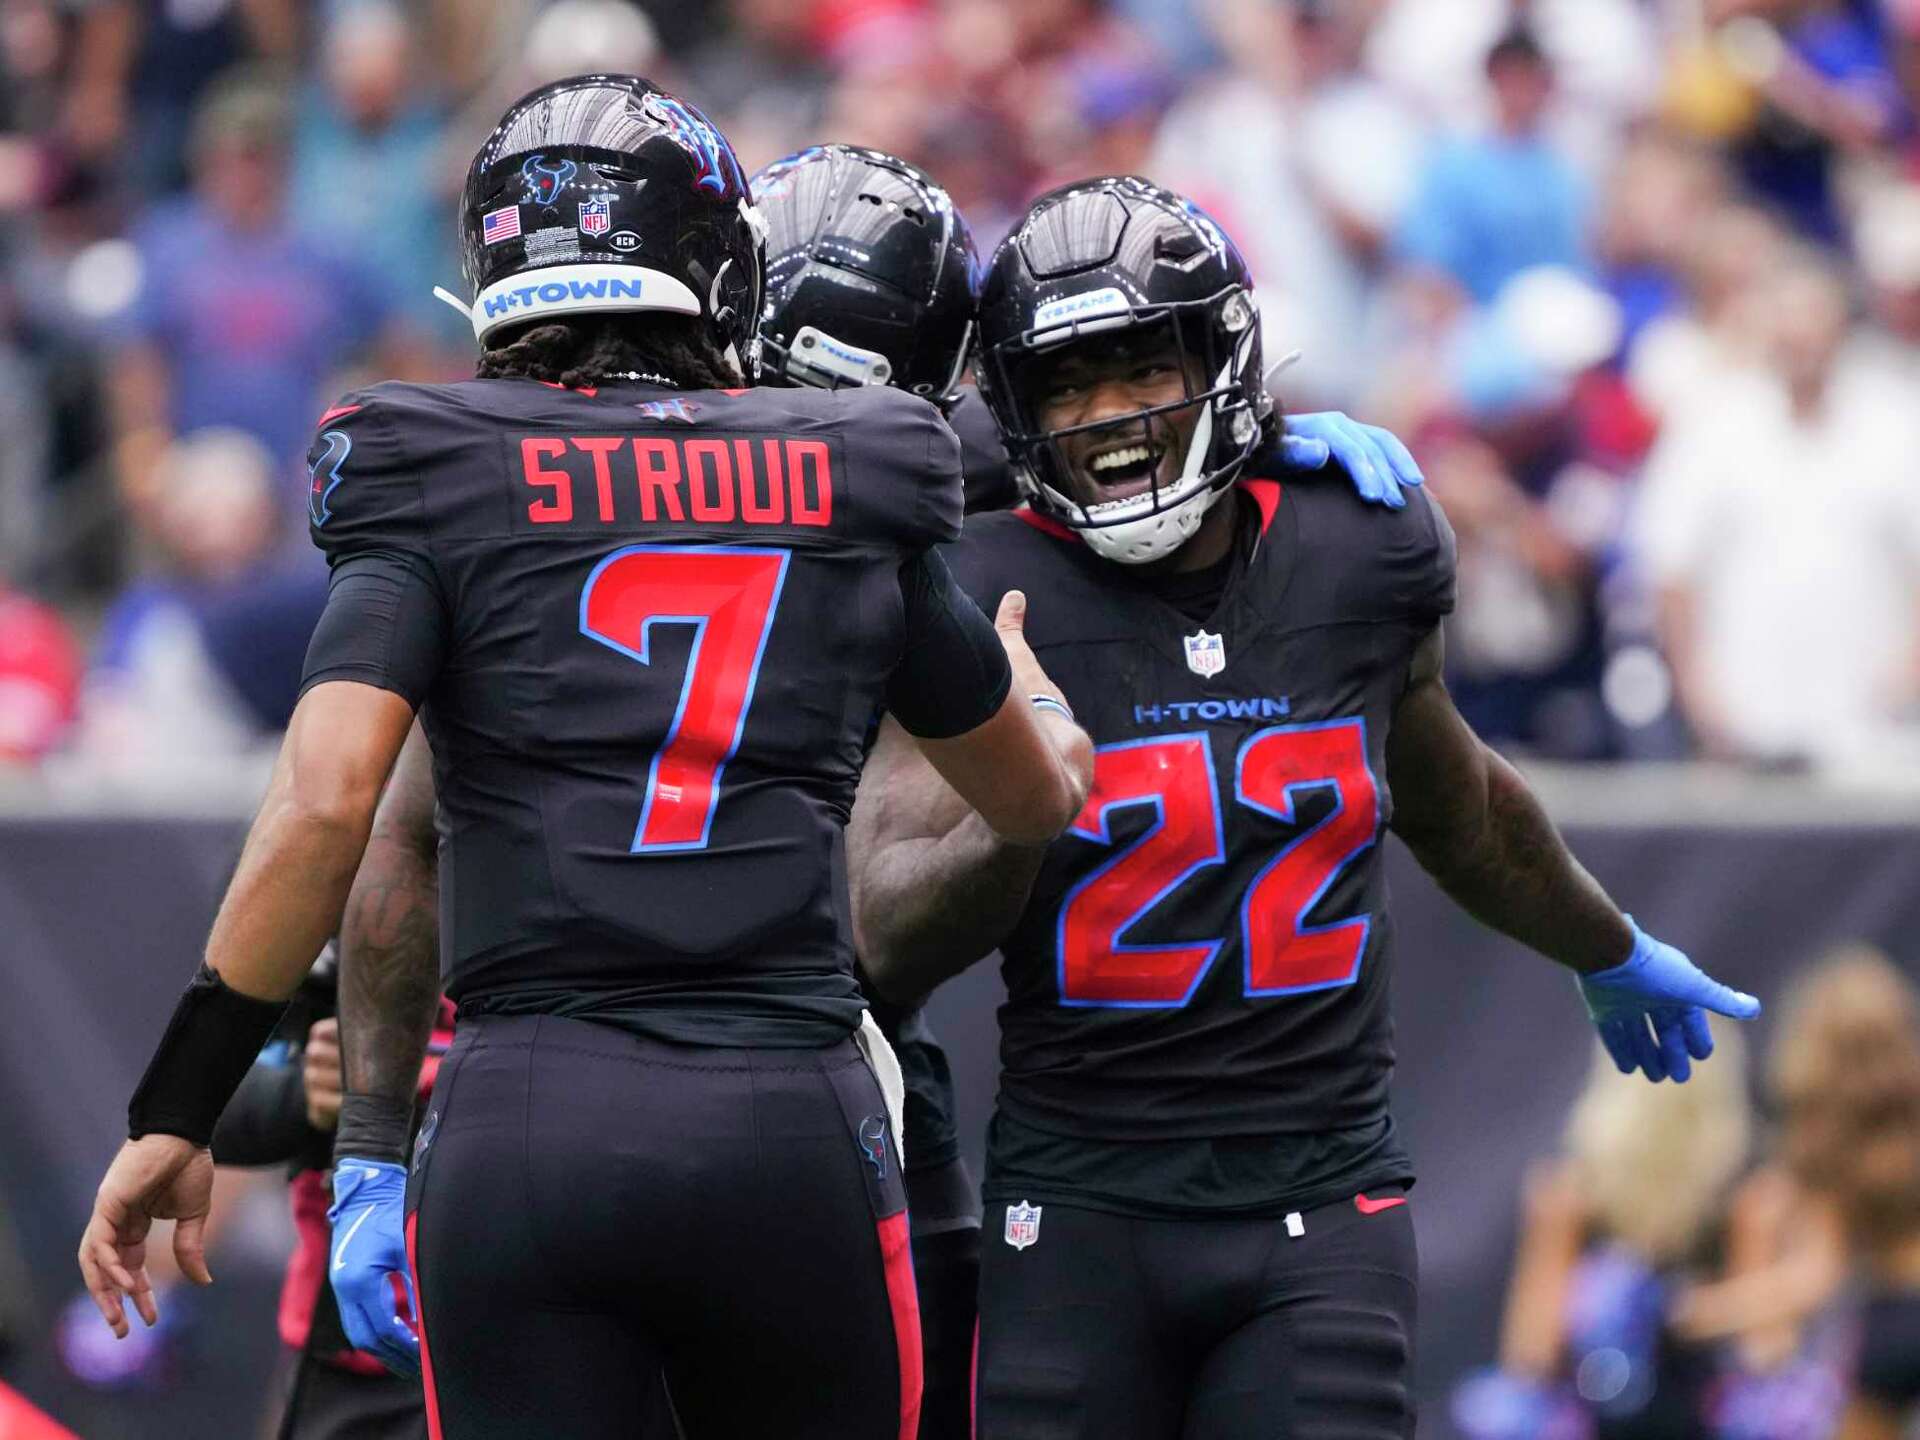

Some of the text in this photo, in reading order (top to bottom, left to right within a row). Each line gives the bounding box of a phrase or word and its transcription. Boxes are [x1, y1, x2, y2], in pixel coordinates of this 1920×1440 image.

[584, 214, 607, 231] NFL
[484, 279, 642, 318] H-TOWN
[1041, 293, 1115, 318] TEXANS
[521, 436, 834, 528] STROUD
[579, 545, 792, 854] 7
[1134, 696, 1291, 724] H-TOWN
[1057, 716, 1380, 1009] 22
